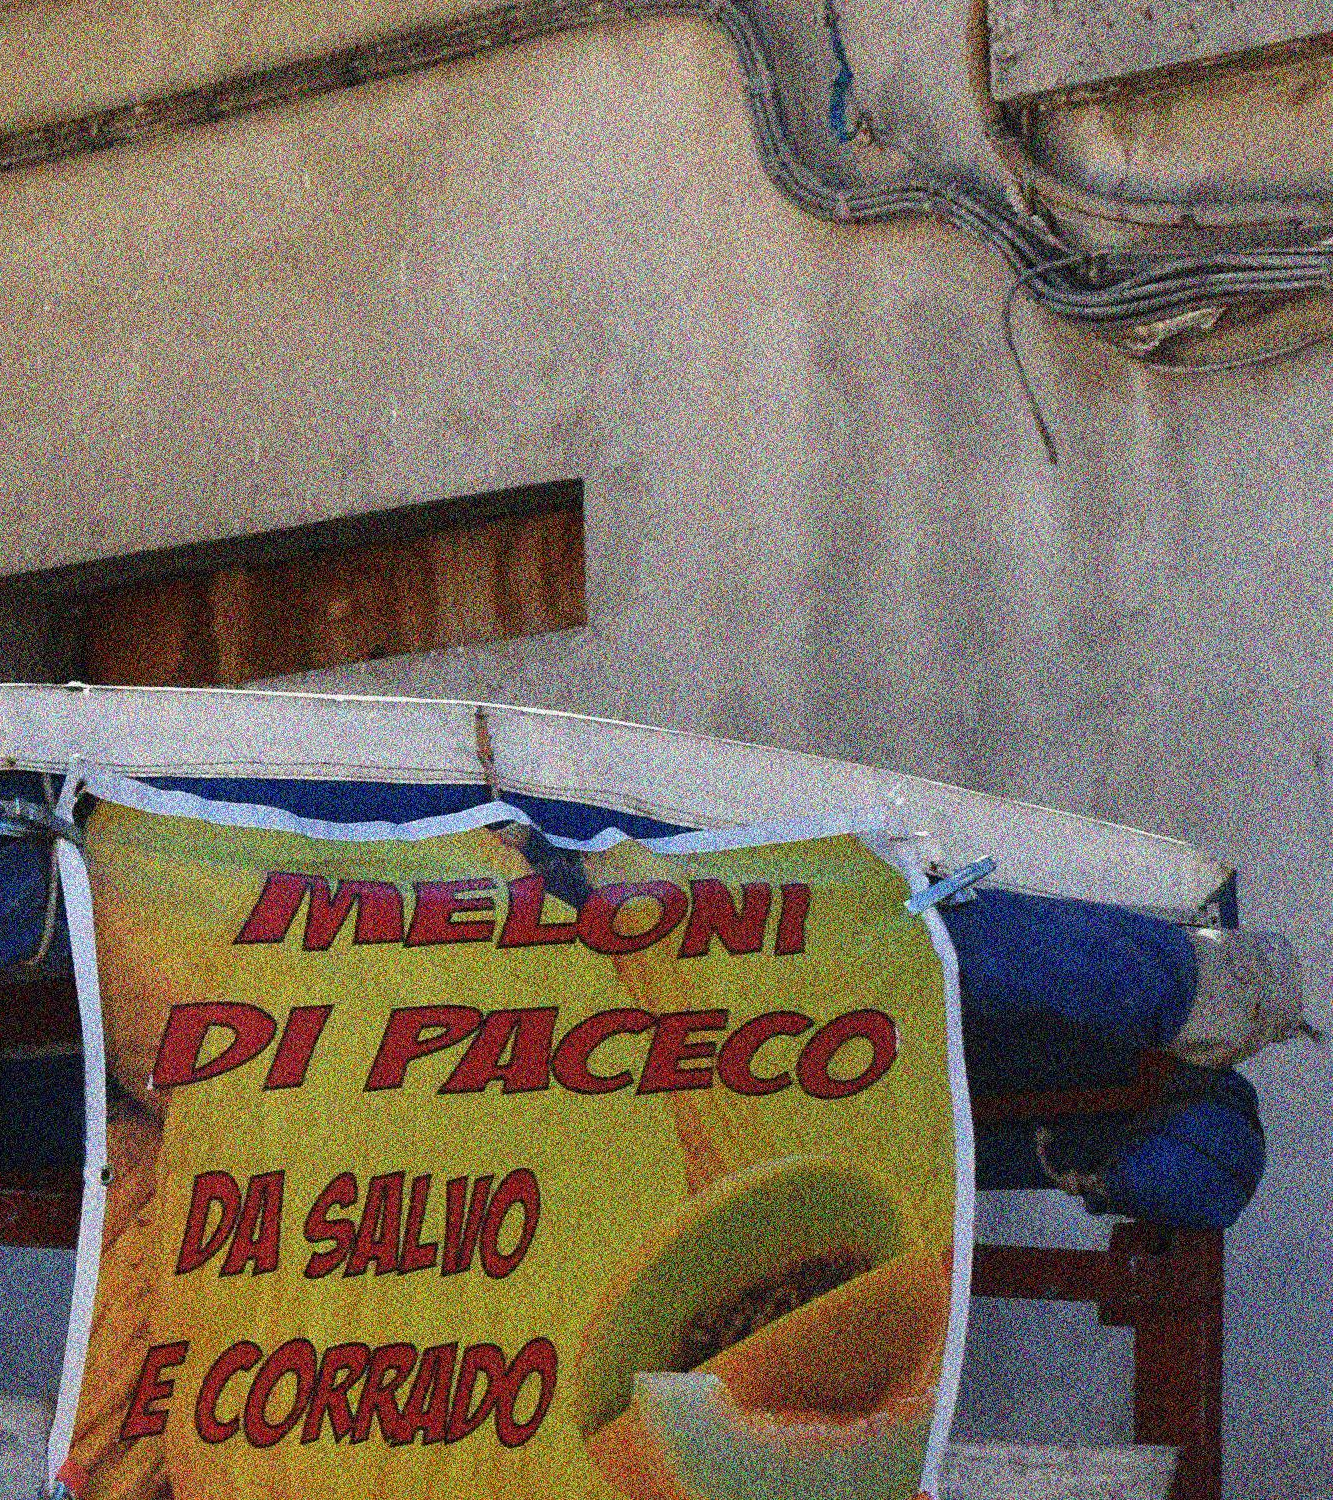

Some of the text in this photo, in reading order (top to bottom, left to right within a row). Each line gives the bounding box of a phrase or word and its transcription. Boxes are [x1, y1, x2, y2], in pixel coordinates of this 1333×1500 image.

[231, 871, 812, 959] MELONI
[150, 1001, 898, 1100] DI PACECO
[174, 1166, 542, 1280] DA SALVO
[119, 1336, 559, 1449] E CORRADO
